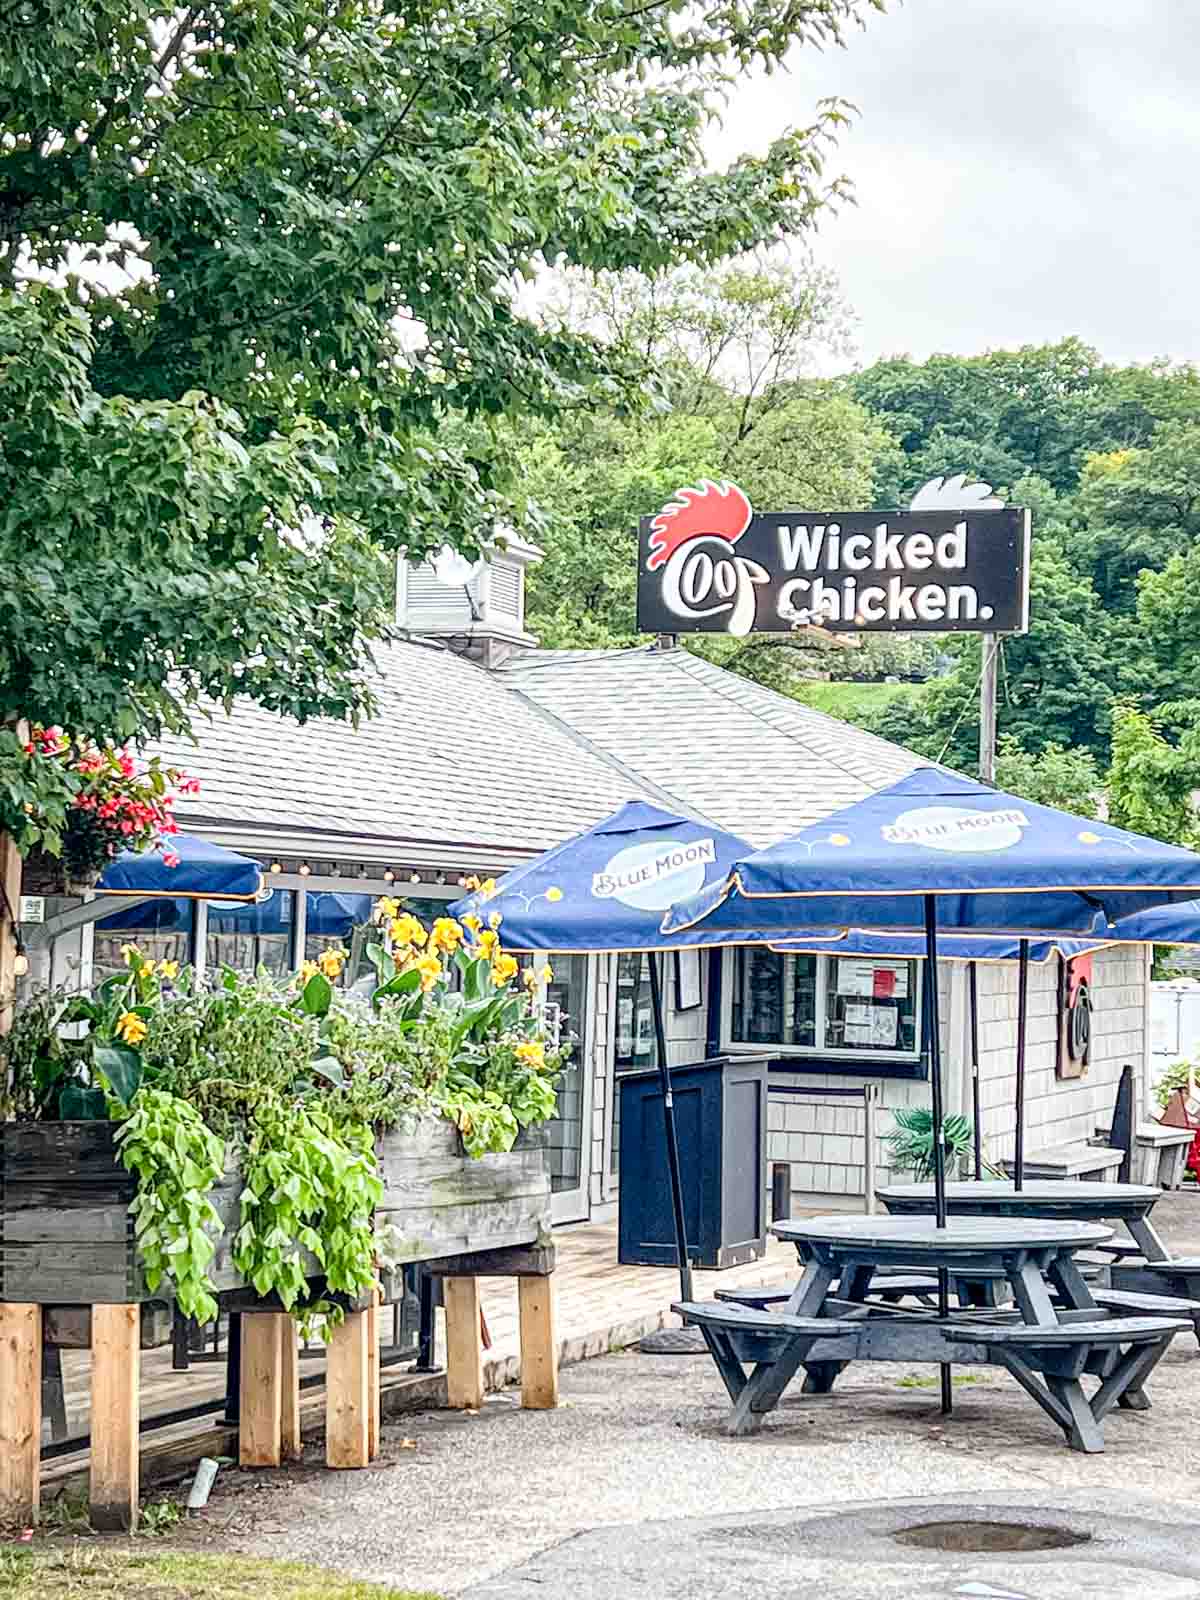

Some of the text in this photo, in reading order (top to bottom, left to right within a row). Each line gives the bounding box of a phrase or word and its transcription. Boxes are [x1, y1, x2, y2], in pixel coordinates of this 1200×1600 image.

[779, 521, 968, 571] Wicked
[777, 576, 994, 624] Chicken.
[956, 811, 1024, 832] MOON
[595, 843, 711, 895] BLUE MOON
